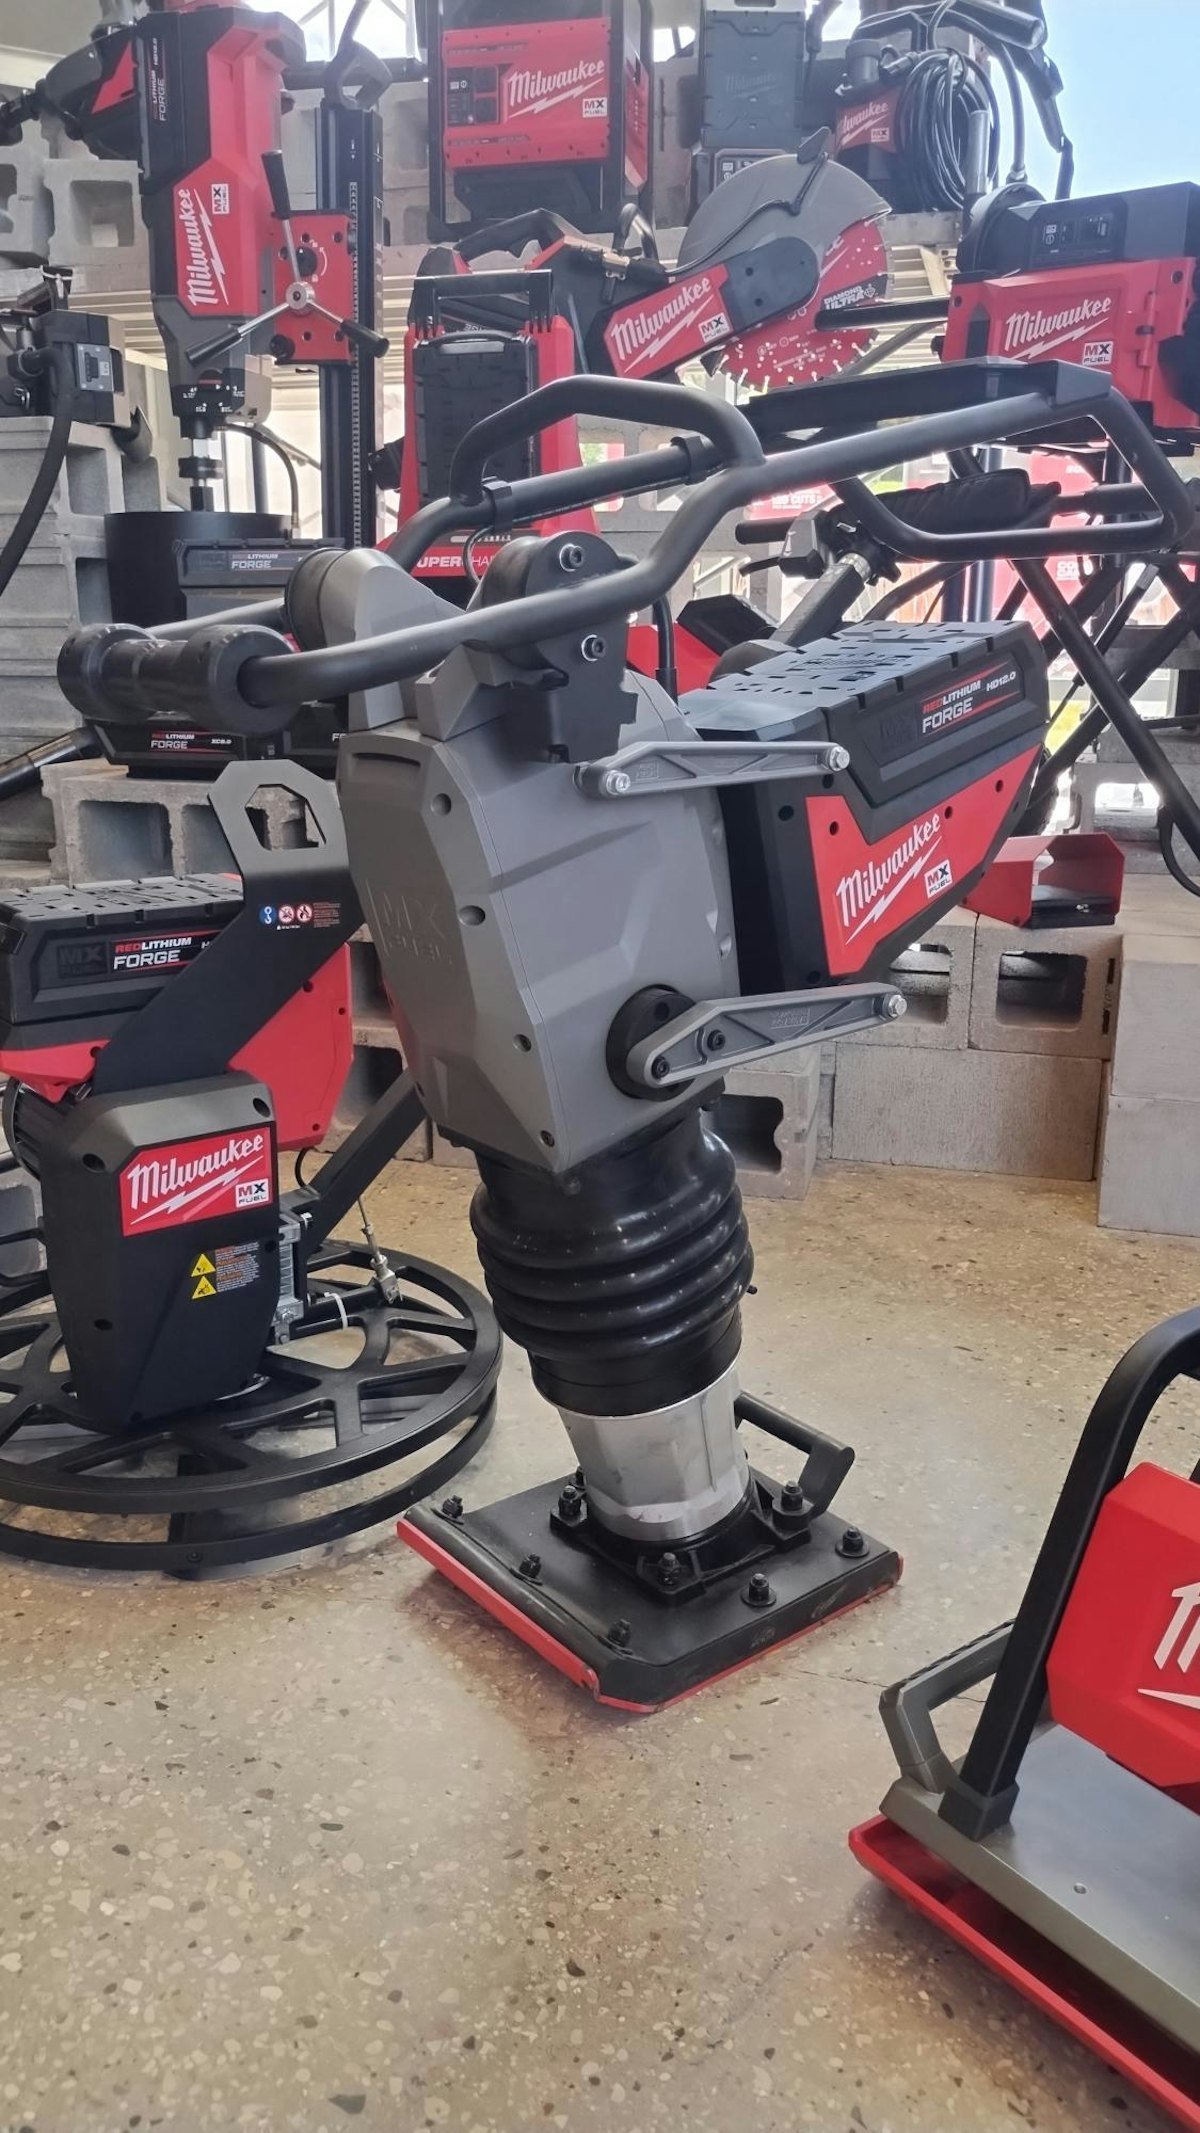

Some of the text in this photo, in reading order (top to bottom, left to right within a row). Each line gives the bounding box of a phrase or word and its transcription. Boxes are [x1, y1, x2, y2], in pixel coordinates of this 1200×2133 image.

[508, 60, 605, 107] Milwaukee
[157, 78, 167, 121] FORGE
[584, 98, 605, 110] MX
[213, 186, 222, 213] MX
[178, 189, 218, 306] Milwaukee
[824, 285, 864, 305] DIAMOND
[611, 277, 711, 360] Milwaukee
[701, 316, 724, 335] MX
[1005, 297, 1111, 351] Milwaukee
[1083, 355, 1109, 364] FUEL
[1085, 343, 1110, 356] MX
[231, 560, 272, 569] FORGE
[922, 671, 1017, 714] REDLITHIUM HD12.0
[922, 697, 974, 733] FORGE
[151, 740, 188, 750] FORGE
[836, 813, 941, 928] Milwaukee
[927, 864, 949, 887] MX
[928, 879, 952, 895] FUEL
[115, 937, 192, 953] REDLITHIUM
[59, 946, 105, 965] MX
[113, 949, 182, 970] FORGE
[127, 1134, 264, 1210] Milwaukee
[238, 1182, 266, 1198] MX
[238, 1195, 267, 1205] FUEL
